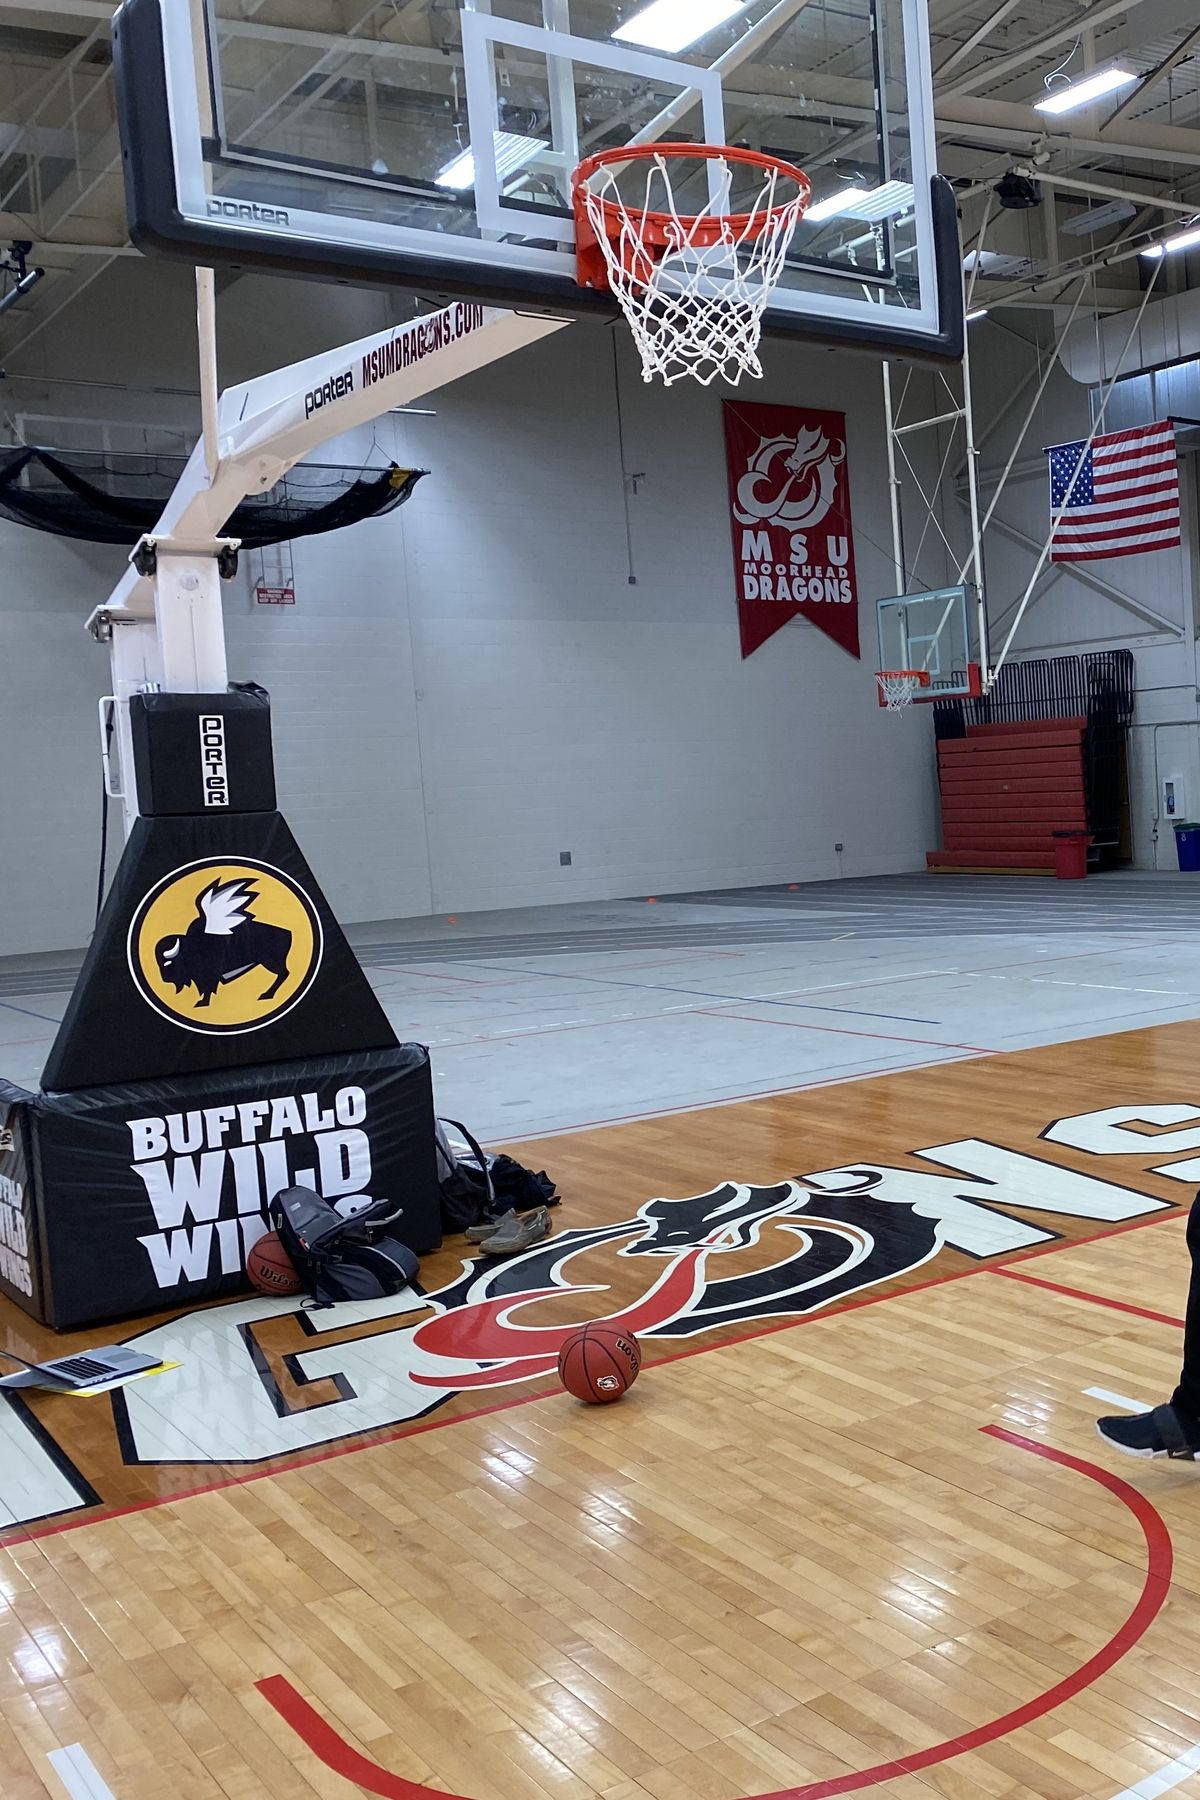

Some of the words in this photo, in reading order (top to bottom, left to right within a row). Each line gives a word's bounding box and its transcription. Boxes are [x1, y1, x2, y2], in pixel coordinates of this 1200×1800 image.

[742, 574, 853, 604] DRAGONS
[744, 562, 849, 579] MOORHEAD
[125, 1086, 367, 1161] BUFFALO
[129, 1128, 372, 1230] WILD
